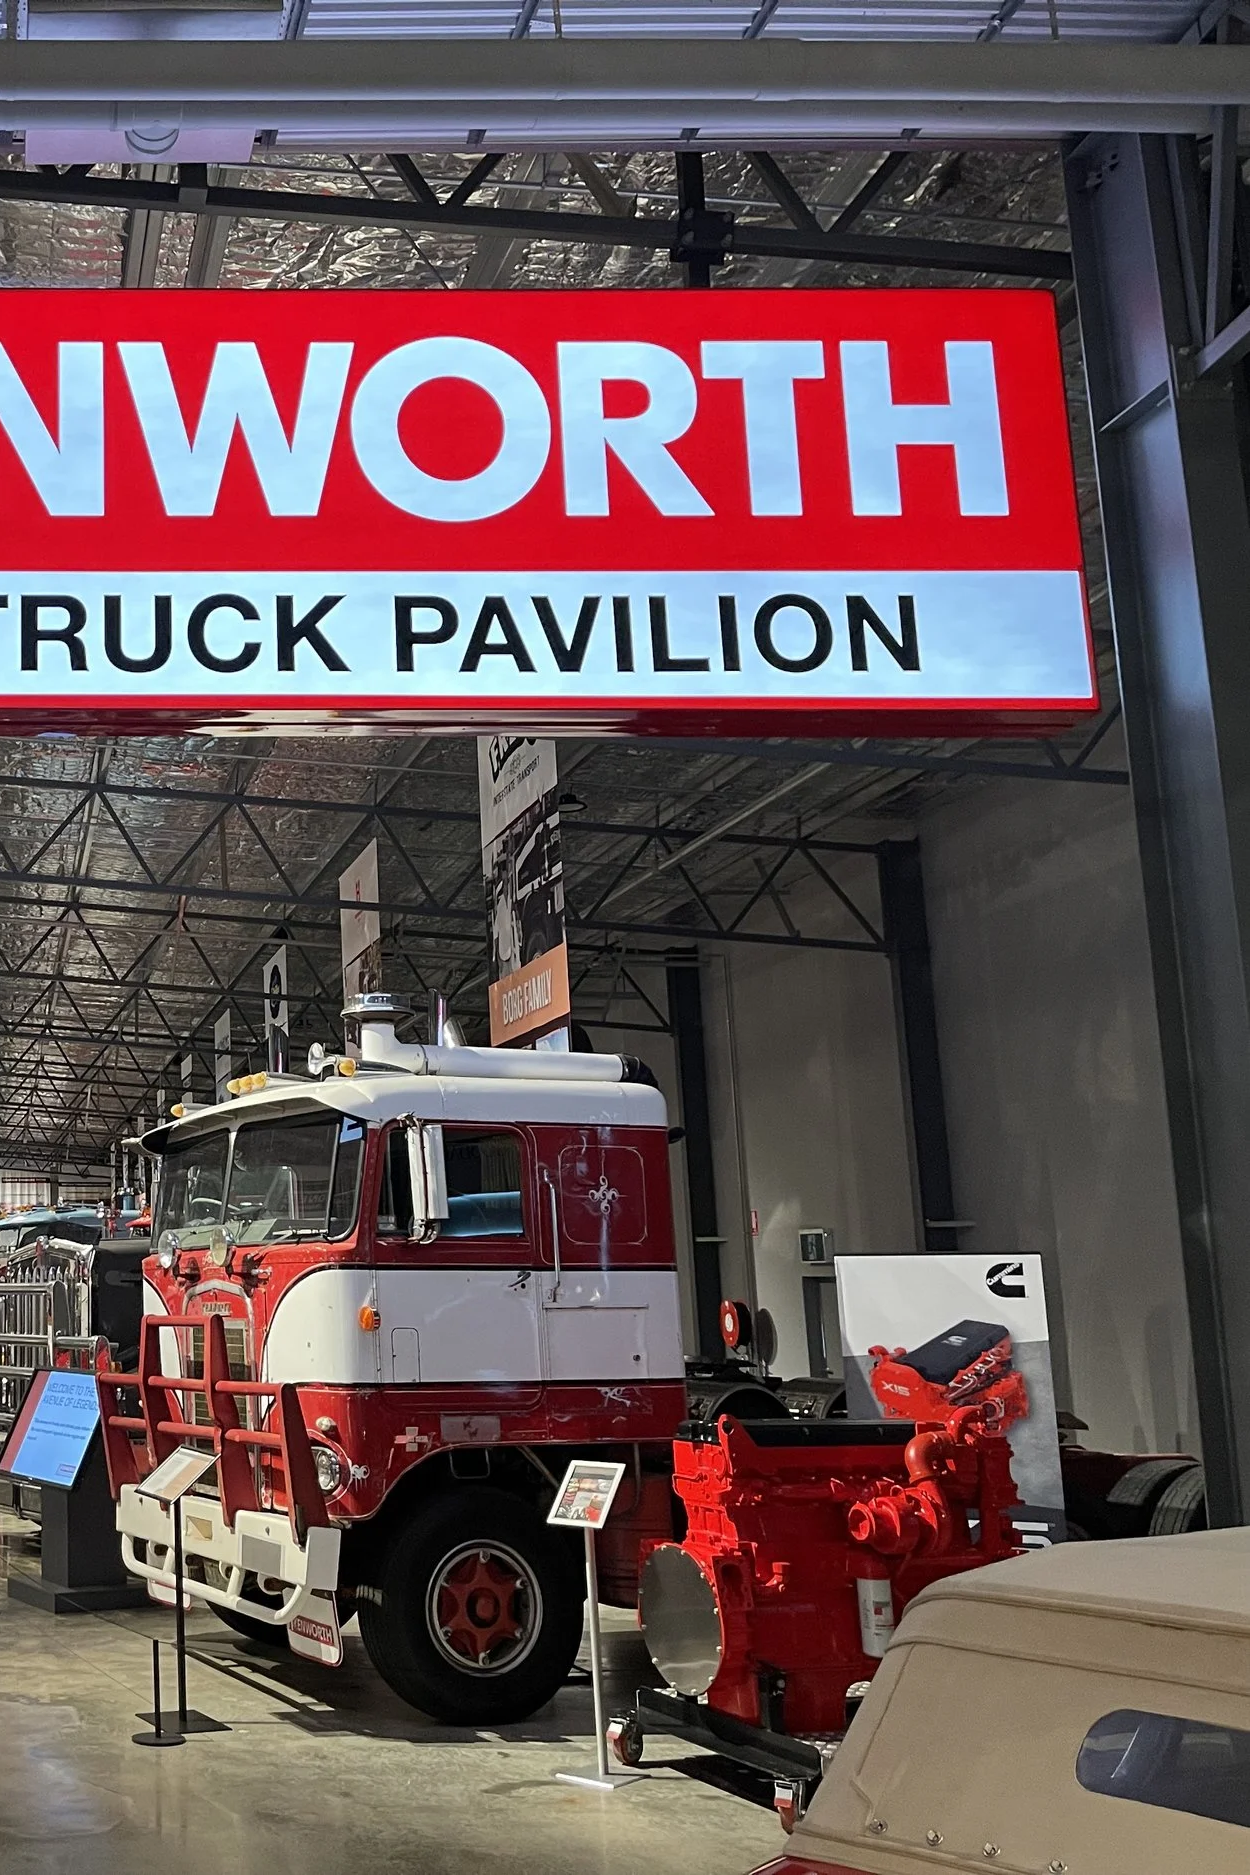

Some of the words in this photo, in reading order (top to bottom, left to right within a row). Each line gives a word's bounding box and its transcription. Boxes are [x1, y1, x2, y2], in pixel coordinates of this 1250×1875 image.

[395, 593, 921, 674] PAVILION
[502, 985, 524, 1025] BORG
[524, 968, 552, 1016] FAMILY
[986, 1262, 1020, 1286] Cummins
[881, 1380, 910, 1397] X15
